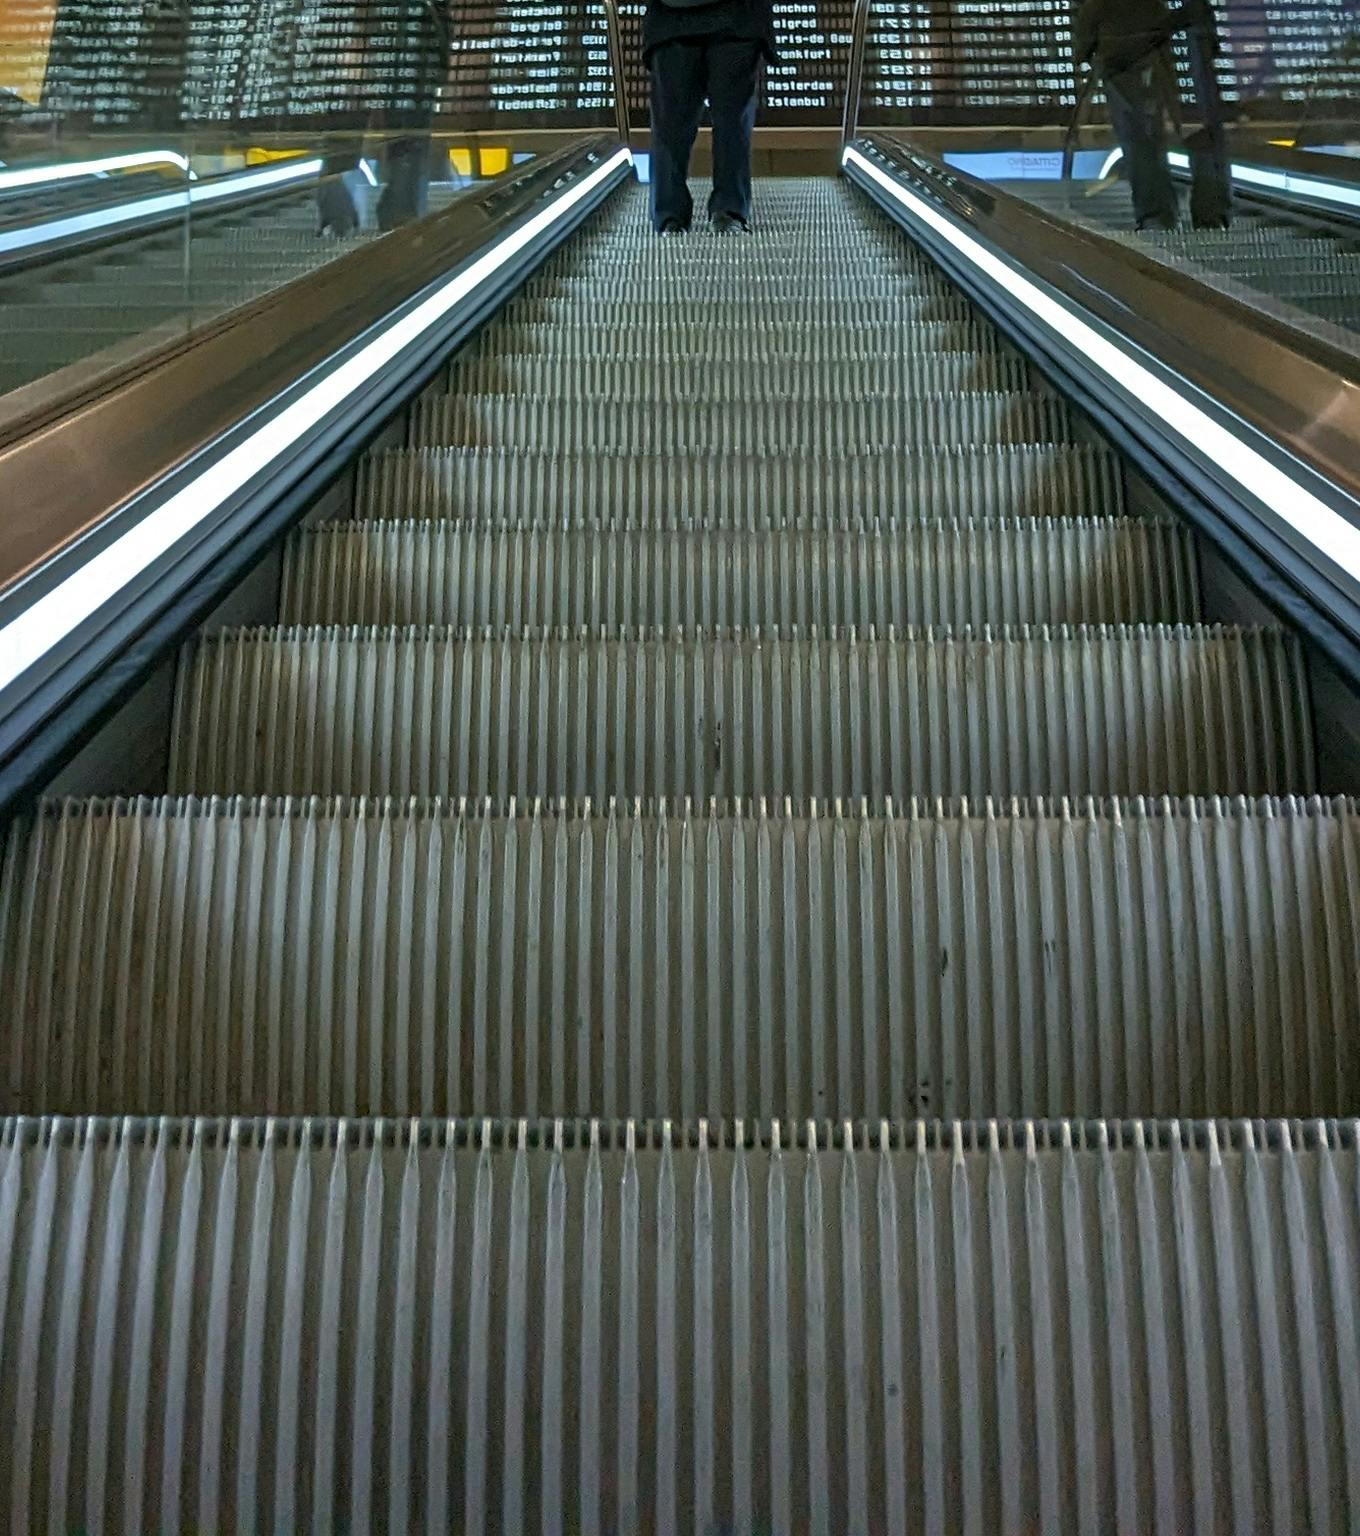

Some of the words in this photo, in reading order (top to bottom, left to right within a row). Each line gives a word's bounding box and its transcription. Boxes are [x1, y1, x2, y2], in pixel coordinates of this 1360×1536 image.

[771, 4, 816, 14] ünchen
[772, 18, 817, 29] elgrad
[767, 81, 834, 91] Amsterdam
[767, 96, 826, 107] Istanbul
